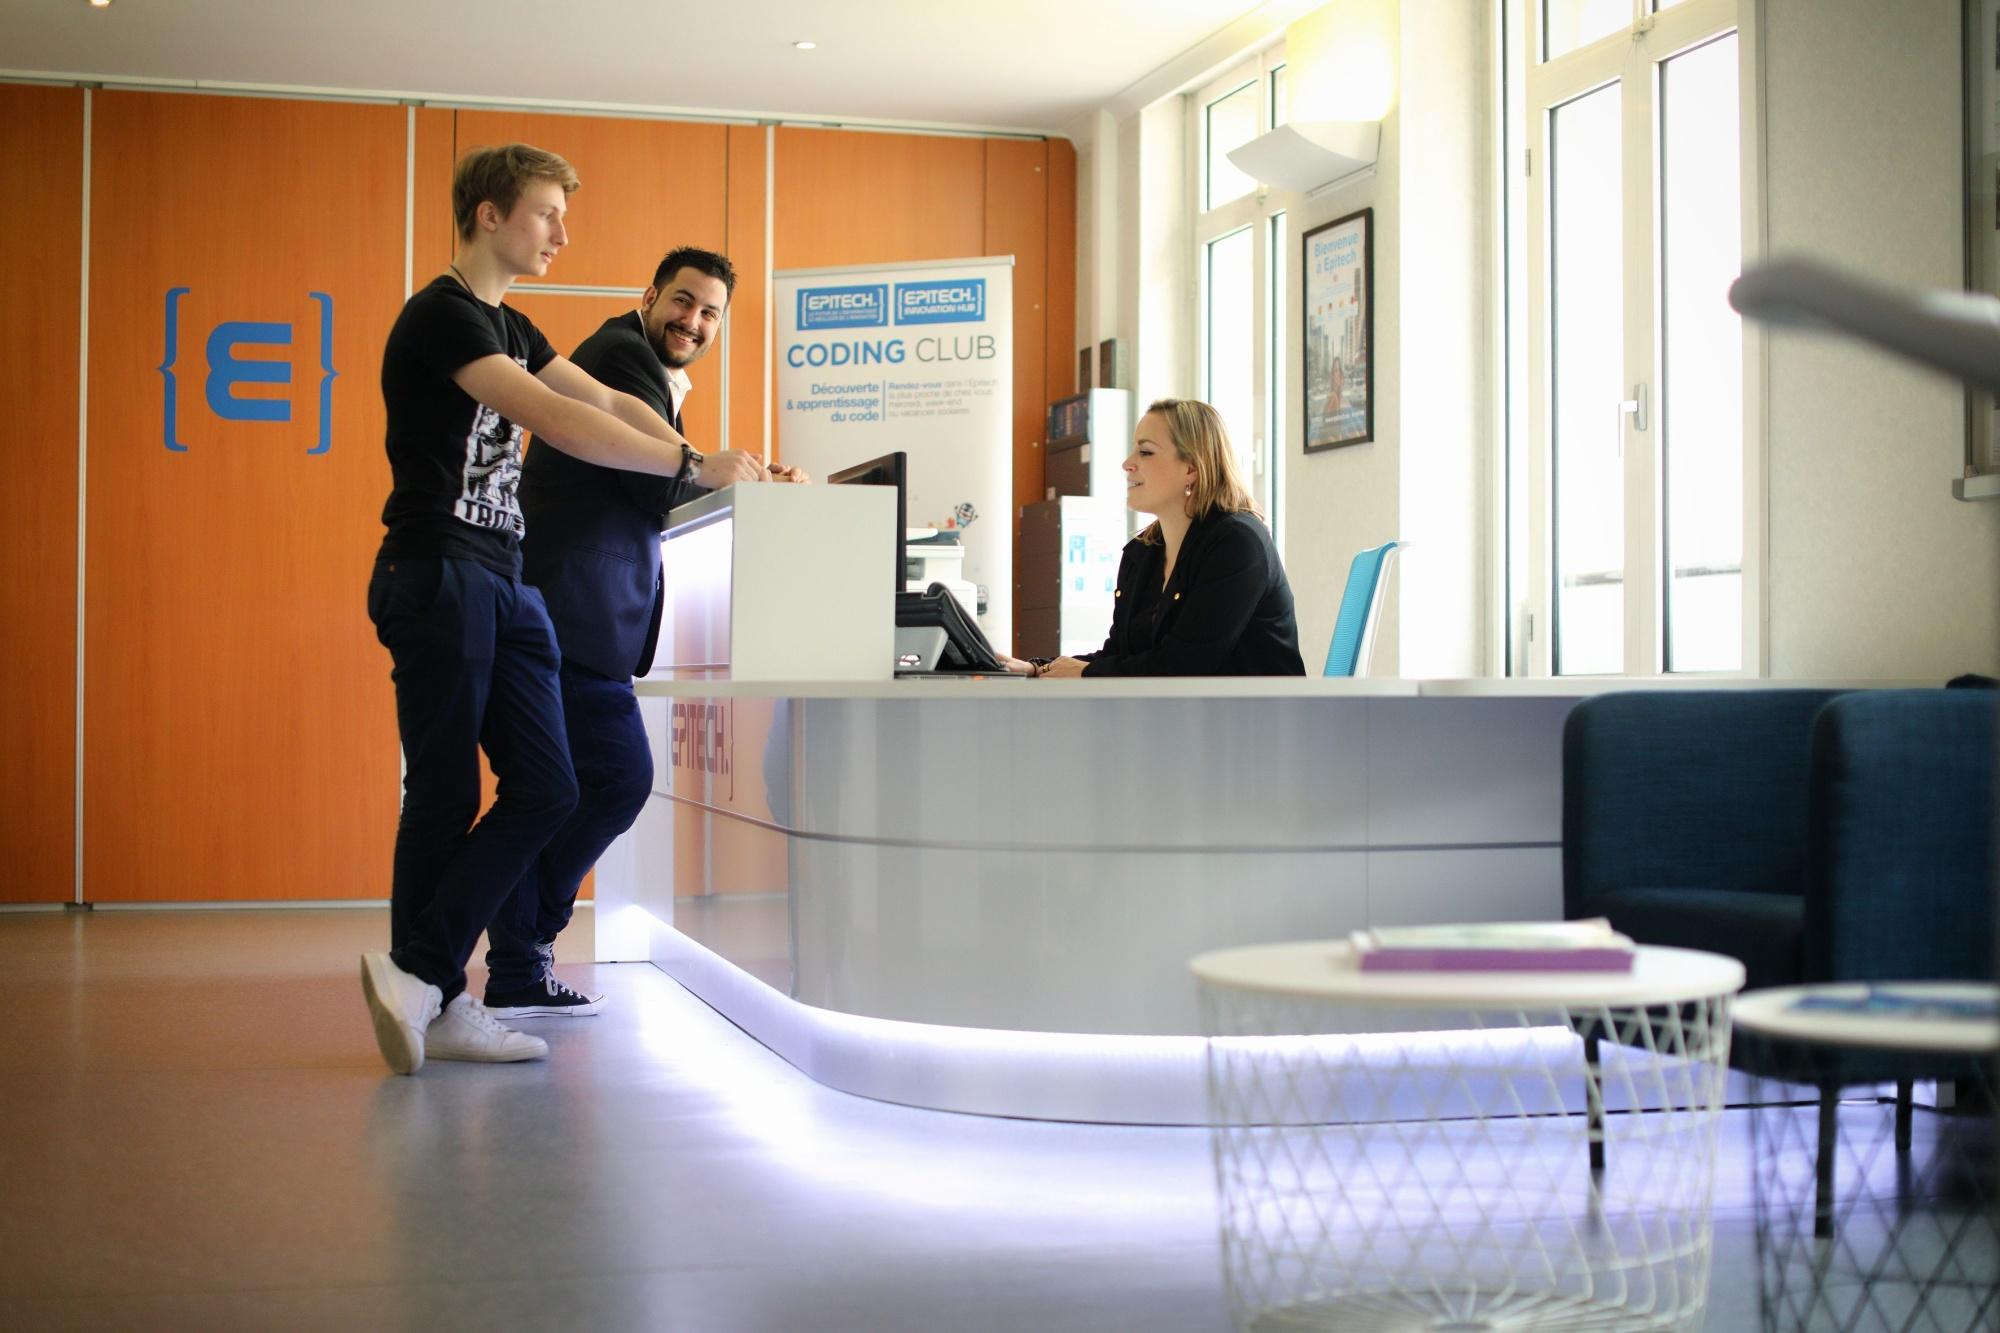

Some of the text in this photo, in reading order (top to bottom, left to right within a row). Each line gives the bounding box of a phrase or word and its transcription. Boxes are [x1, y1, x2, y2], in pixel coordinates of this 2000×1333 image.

[957, 303, 976, 313] HUB
[787, 335, 996, 368] CODING CLUB
[811, 381, 879, 395] Découverte
[796, 396, 879, 412] apprentissage
[831, 409, 879, 422] du code
